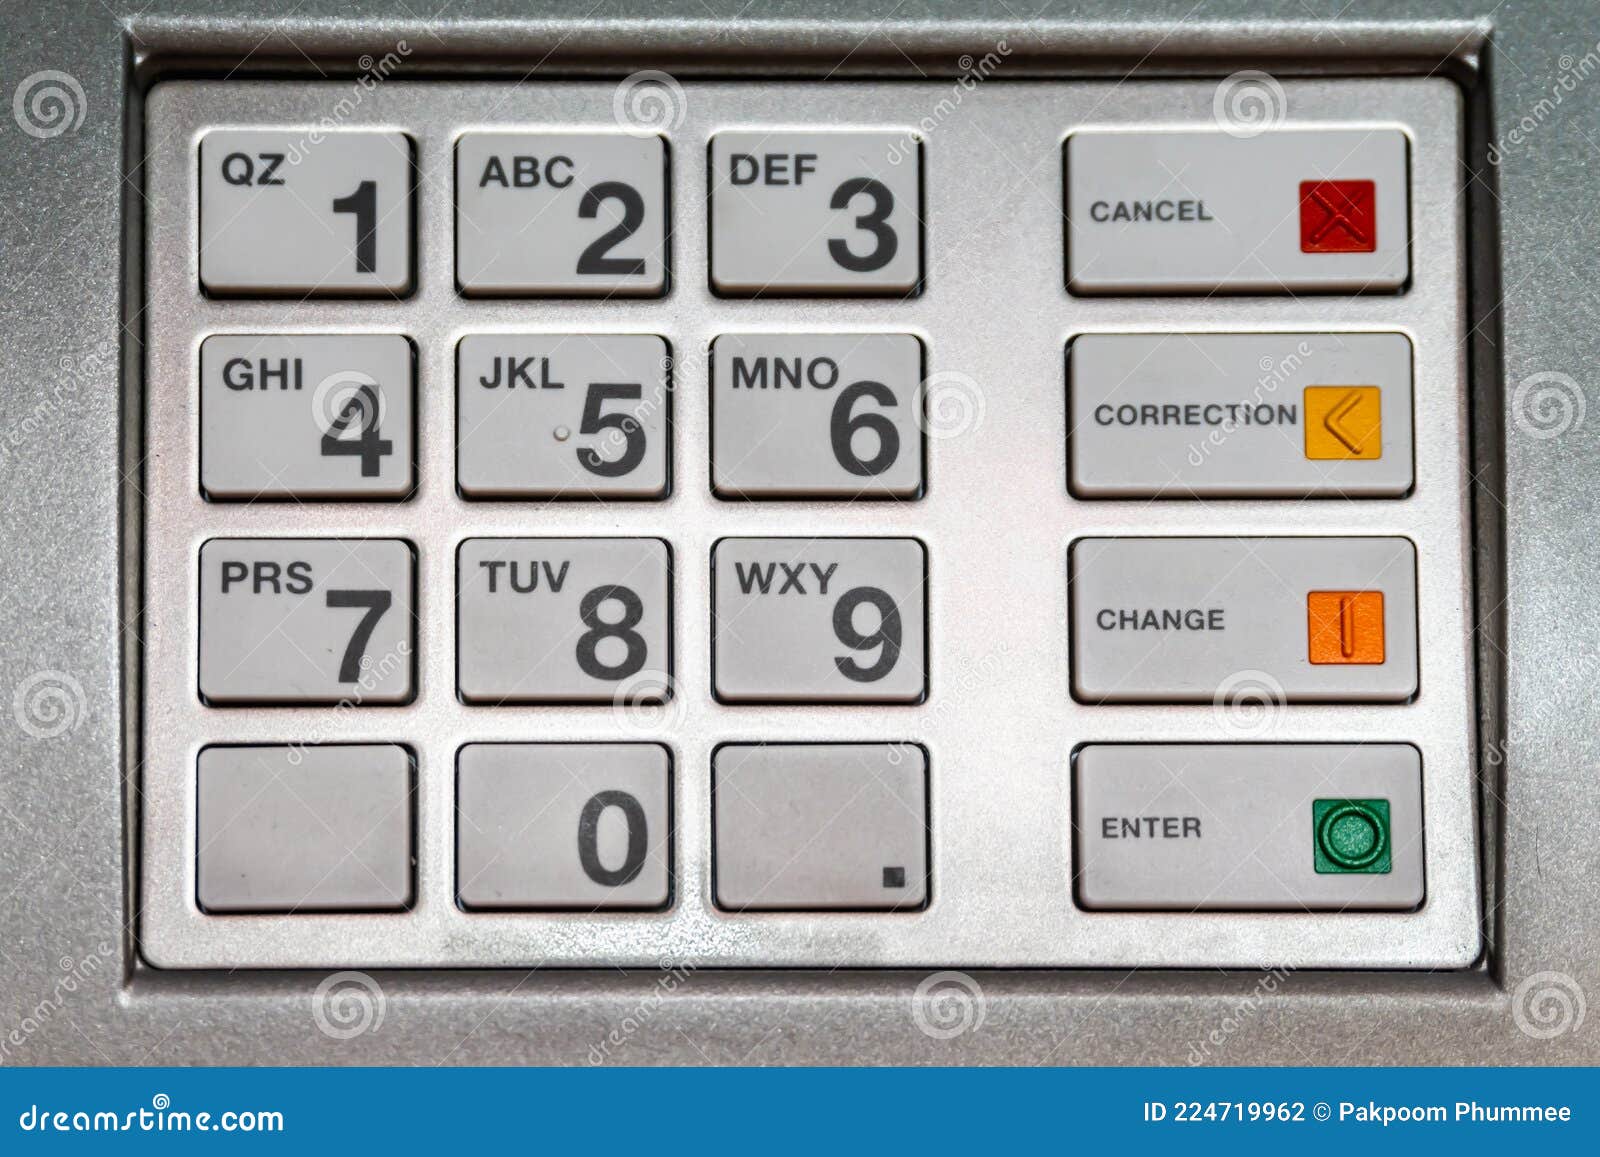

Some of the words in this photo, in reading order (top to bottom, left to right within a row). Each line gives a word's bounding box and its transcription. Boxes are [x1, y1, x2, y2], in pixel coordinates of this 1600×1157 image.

[222, 153, 285, 187] QZ
[480, 156, 574, 188] ABC
[731, 154, 817, 186] DEF
[333, 181, 377, 273] 1
[828, 178, 898, 272] 3
[1091, 201, 1213, 222] CANCEL
[576, 182, 646, 275] 2
[223, 358, 303, 391] GHI
[480, 357, 565, 389] JKL
[732, 357, 839, 389] MNO
[321, 385, 393, 477] 4
[577, 383, 647, 477] 5
[829, 381, 900, 476] 6
[1095, 404, 1297, 425] CORRECTION
[222, 562, 314, 594] PRS
[480, 561, 570, 593] TUV
[735, 562, 839, 594] WXY
[576, 585, 647, 680] 8
[833, 587, 902, 682] 9
[1097, 609, 1225, 630] CHANGE
[326, 590, 392, 683] 7
[578, 791, 648, 887] 0
[1102, 817, 1201, 838] ENTER
